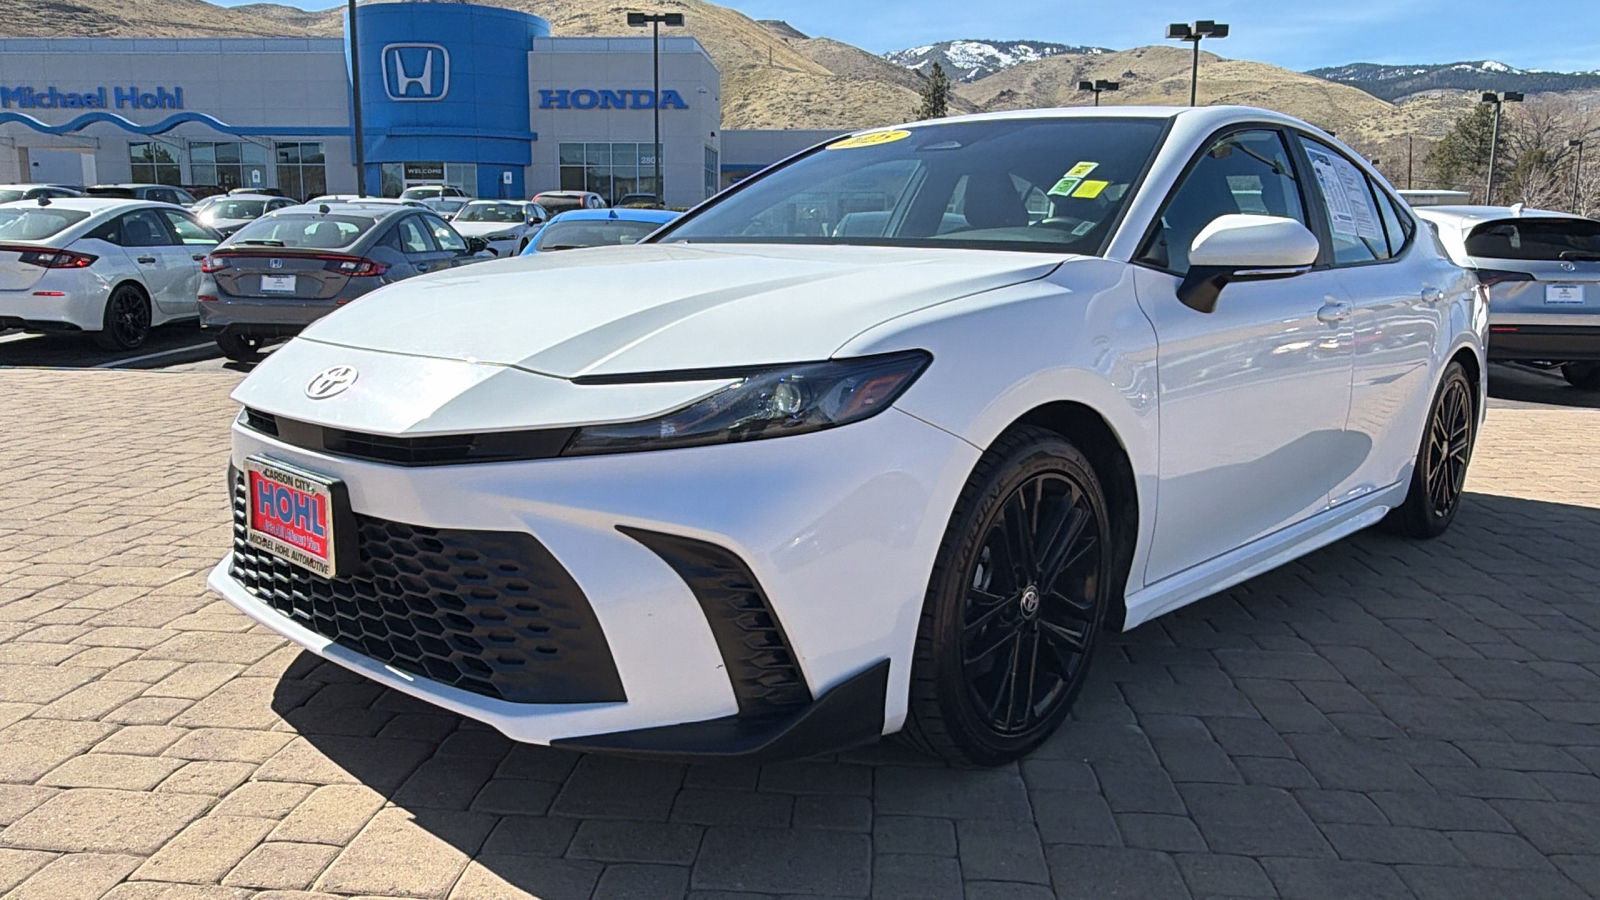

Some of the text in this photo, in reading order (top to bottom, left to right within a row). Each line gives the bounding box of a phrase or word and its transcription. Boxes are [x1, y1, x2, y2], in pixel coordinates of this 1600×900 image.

[0, 86, 184, 109] Michael Hohl
[538, 89, 689, 110] HONDA
[264, 468, 311, 492] CARSON CITY
[257, 480, 325, 538] HOHL
[249, 533, 330, 575] MICHAEL HOHL AUTOMOTIVE
